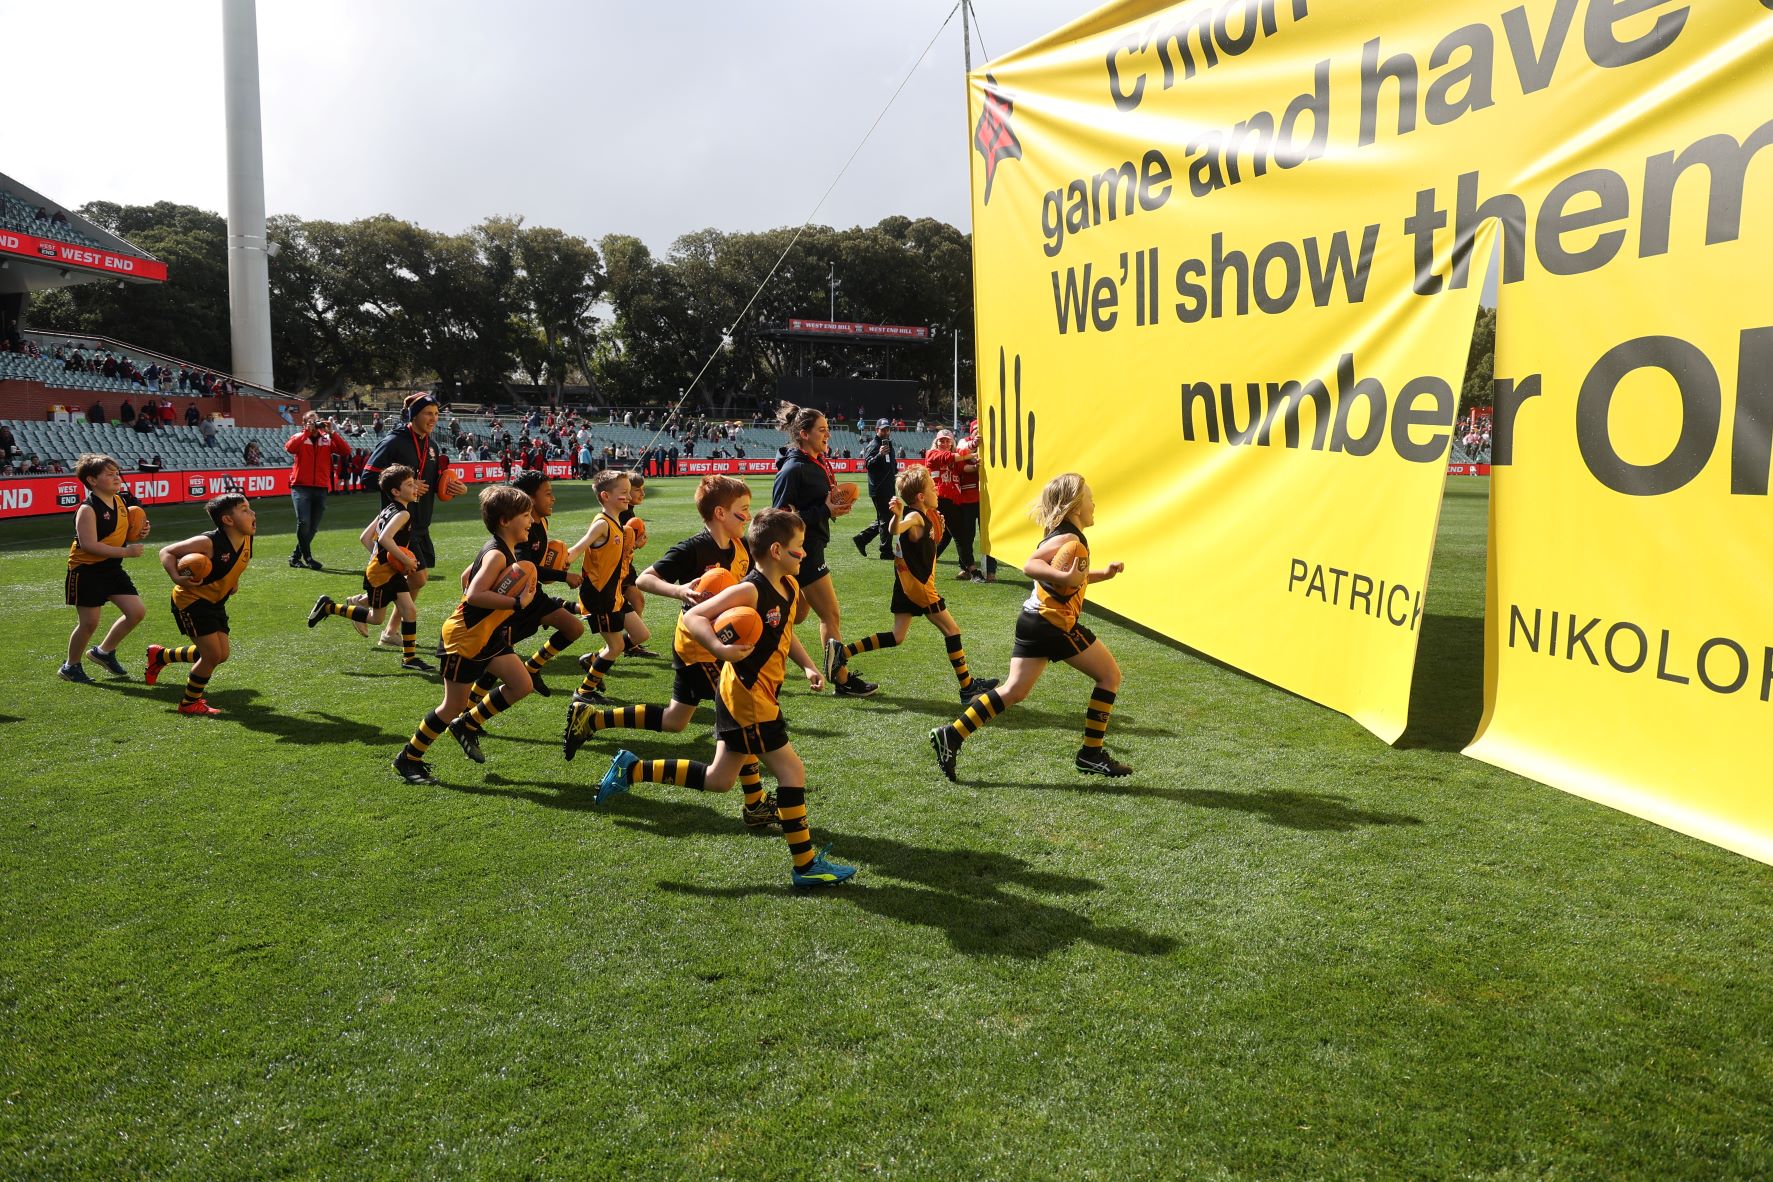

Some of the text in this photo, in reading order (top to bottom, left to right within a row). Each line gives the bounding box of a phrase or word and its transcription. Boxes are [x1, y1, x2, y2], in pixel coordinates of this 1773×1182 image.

[1041, 0, 1690, 257] game and have
[1051, 118, 1773, 334] We'll show them
[0, 236, 19, 249] ND
[61, 247, 133, 271] WEST END
[1181, 354, 1542, 468] number
[485, 466, 505, 478] WES
[546, 465, 566, 476] WEST
[689, 463, 712, 472] WEST
[712, 462, 730, 471] END
[748, 462, 770, 471] WEST
[58, 484, 79, 494] WEST
[189, 477, 205, 485] WEST
[248, 475, 275, 491] END
[135, 480, 169, 499] END
[0, 488, 33, 510] ND
[61, 496, 76, 505] END
[497, 577, 512, 594] nab
[1508, 604, 1773, 702] NIKOLO
